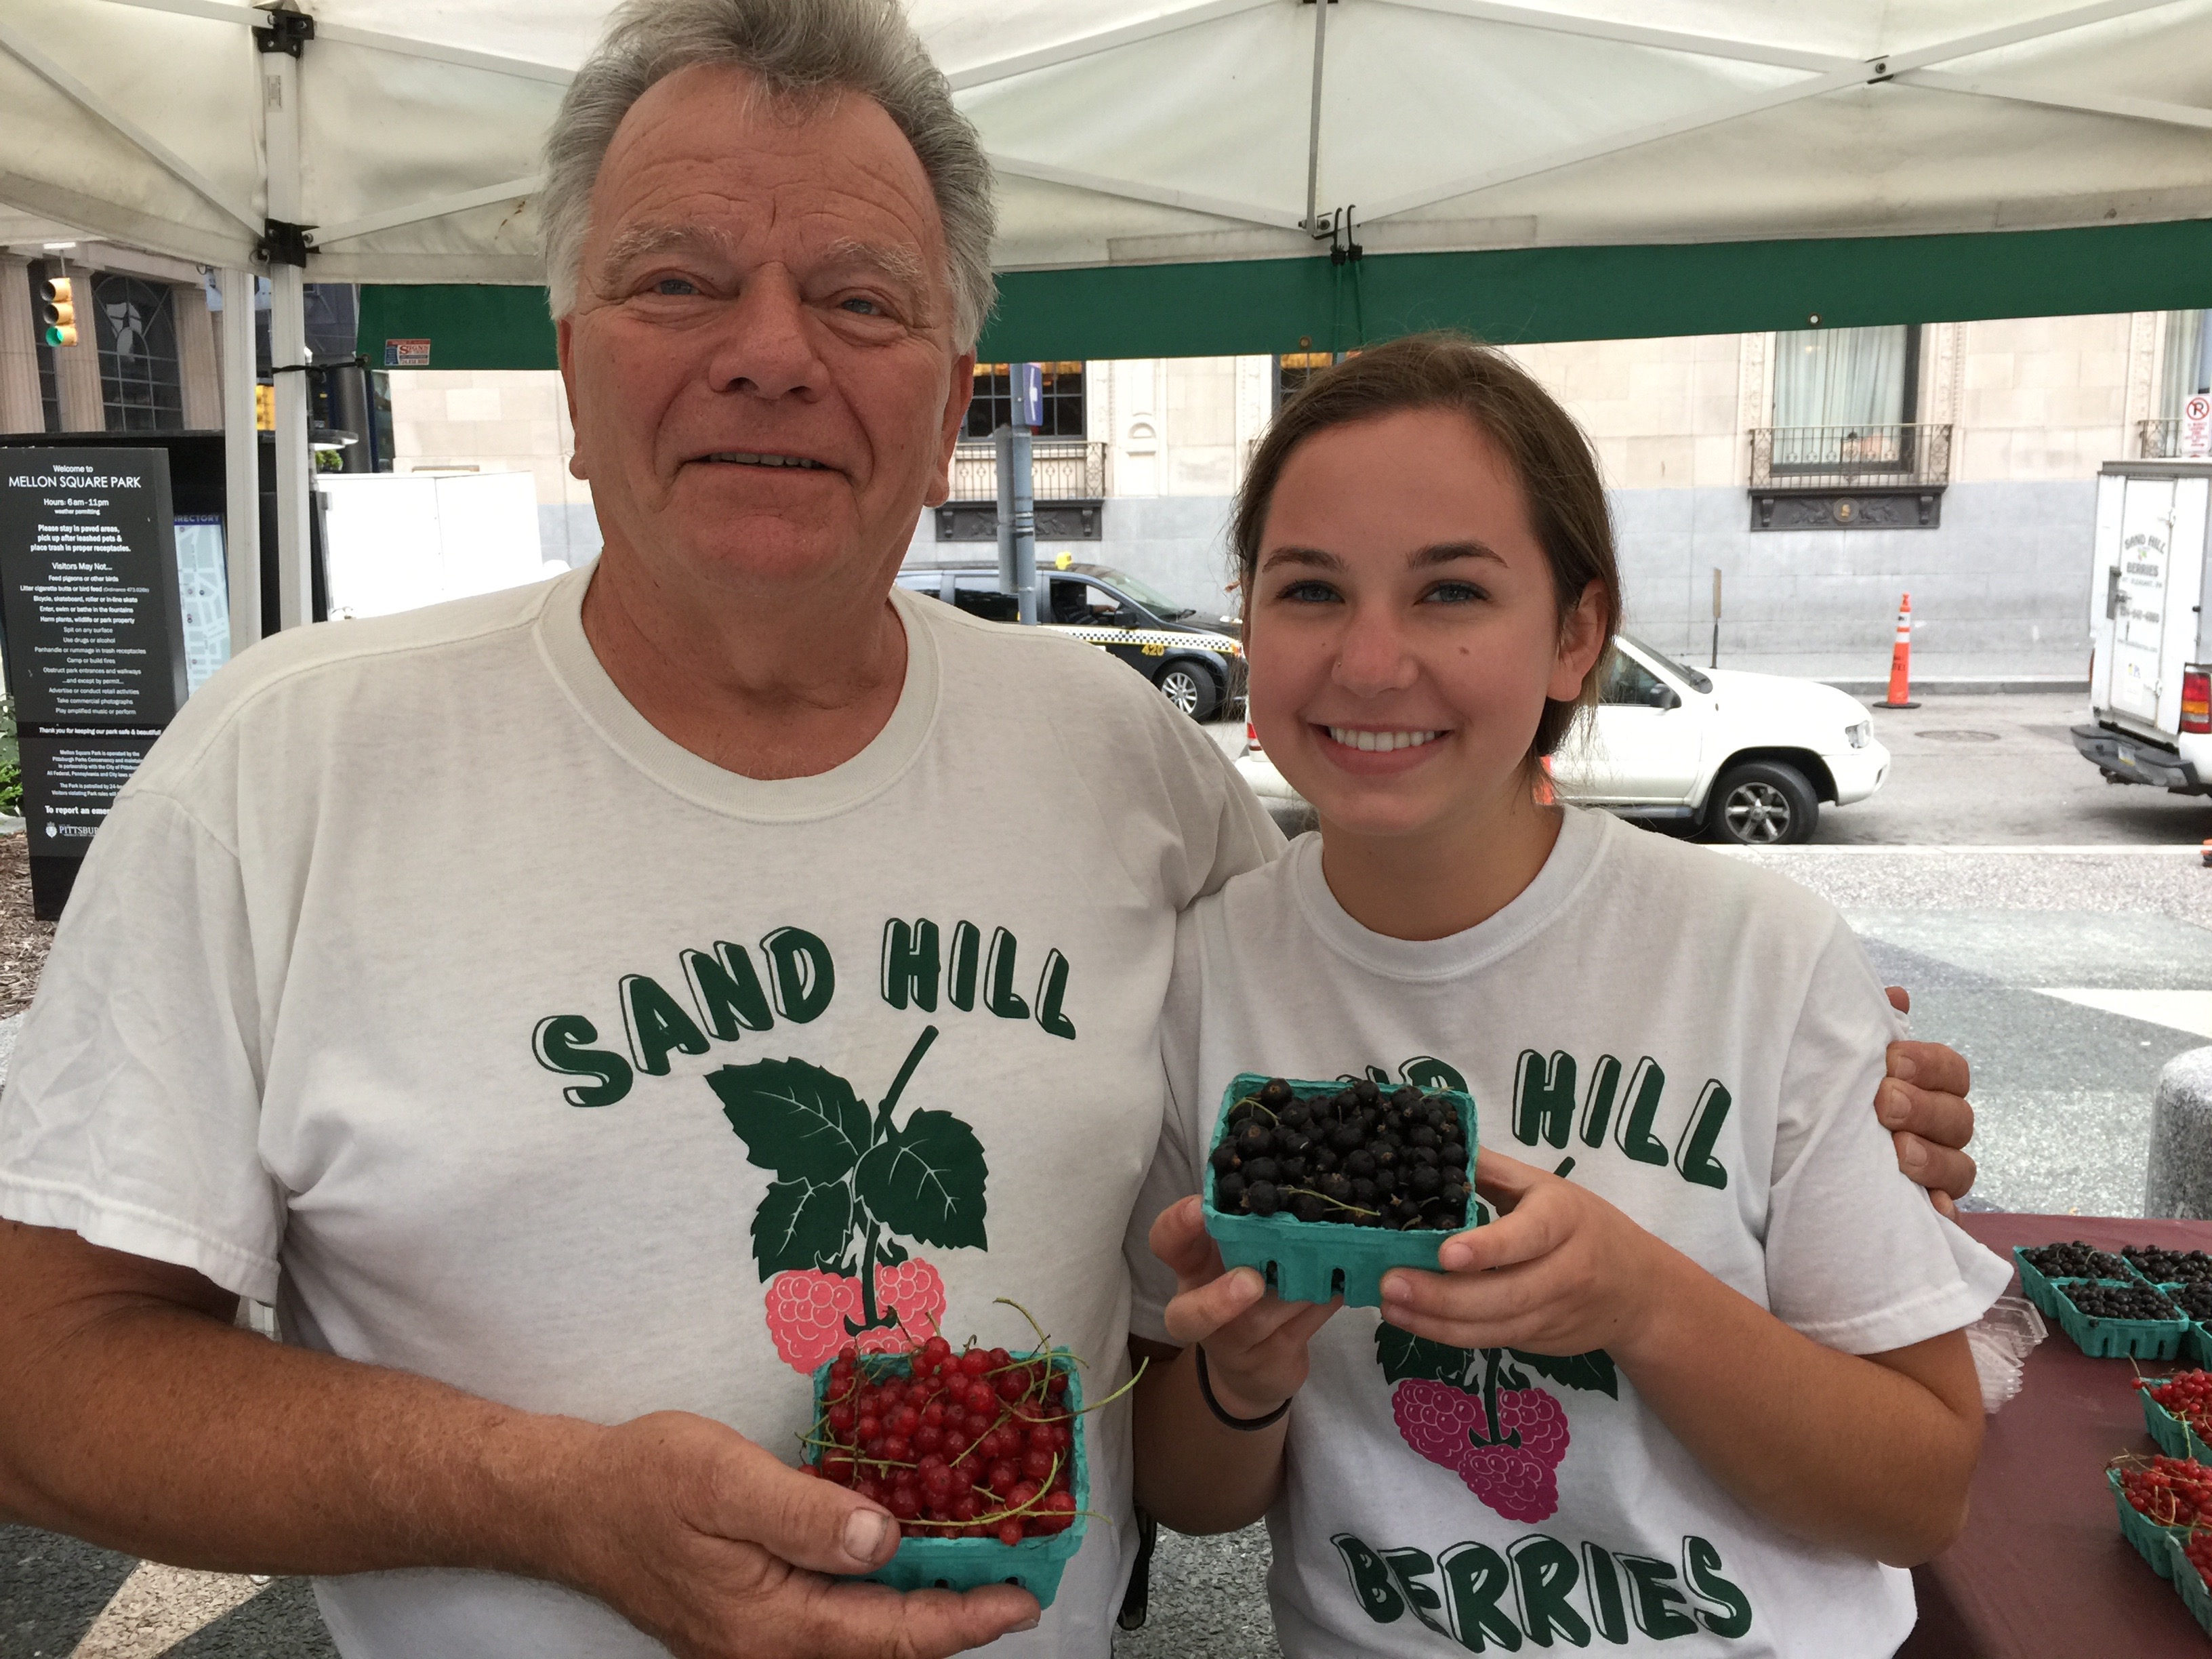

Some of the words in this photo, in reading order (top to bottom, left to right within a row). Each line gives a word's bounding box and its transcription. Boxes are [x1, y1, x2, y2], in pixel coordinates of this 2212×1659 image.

[9, 476, 57, 487] MELLON
[60, 476, 108, 488] SQUARE
[110, 476, 142, 488] PARK
[59, 525, 73, 533] stay
[81, 525, 100, 533] paved
[37, 534, 52, 542] pick
[2125, 533, 2146, 550] SAND
[2148, 535, 2165, 554] HILL
[30, 544, 47, 552] place
[78, 562, 93, 571] May
[2127, 561, 2158, 577] BERRIES
[1141, 643, 1165, 656] 420
[45, 805, 54, 814] To
[56, 806, 79, 815] report
[531, 926, 835, 1107] SAND
[881, 918, 1076, 1040] HILL
[1511, 1049, 1732, 1189] HILL
[1330, 1533, 1753, 1654] BERRIES
